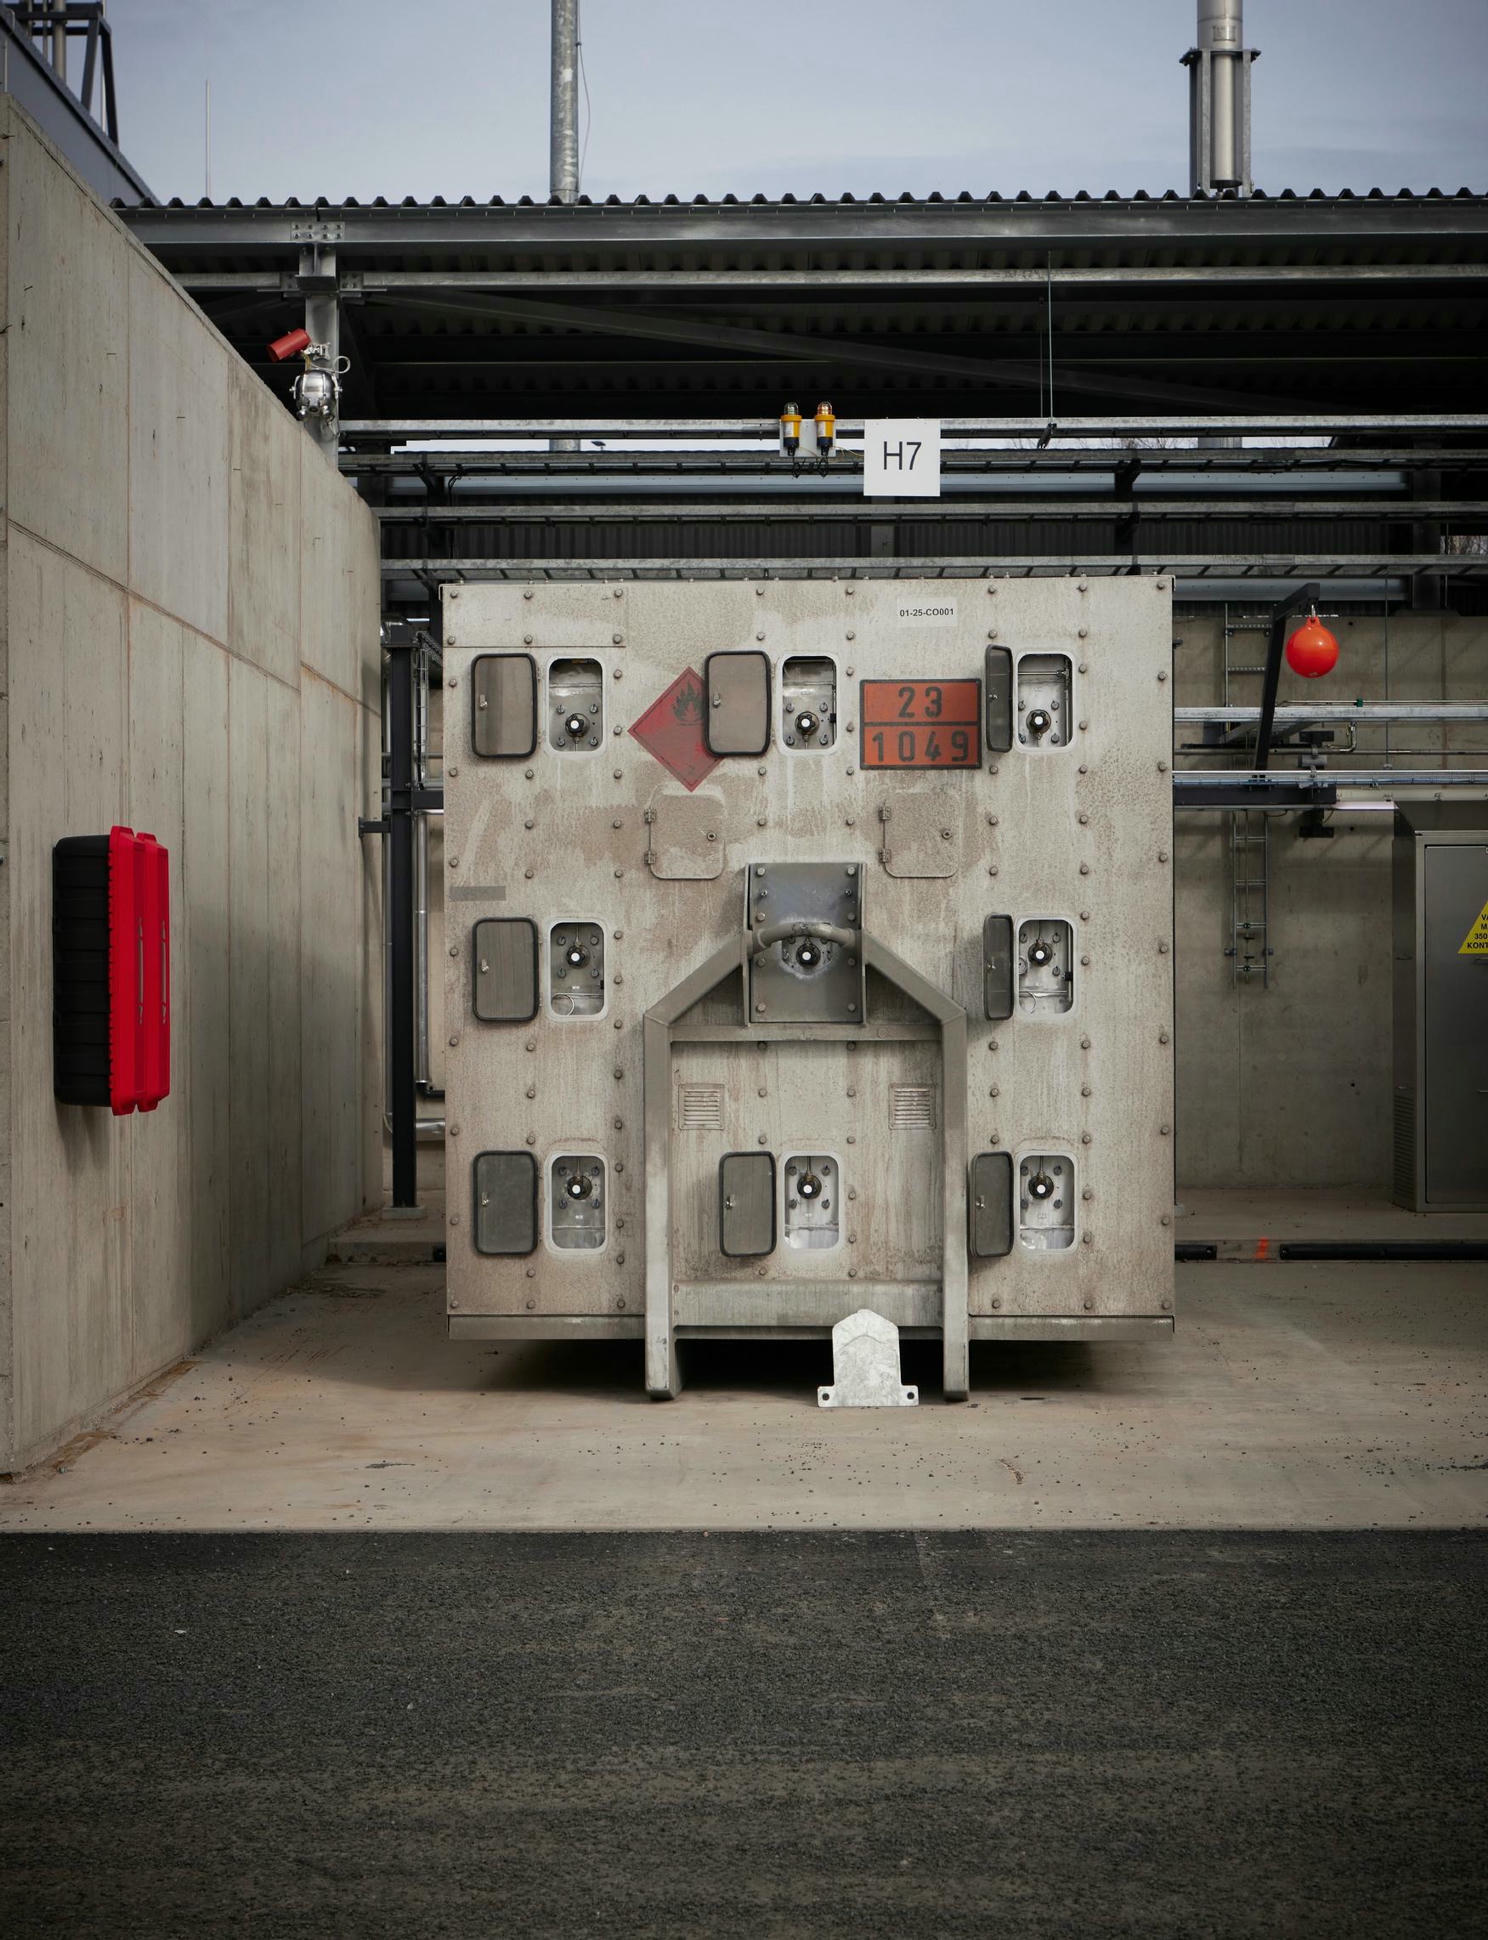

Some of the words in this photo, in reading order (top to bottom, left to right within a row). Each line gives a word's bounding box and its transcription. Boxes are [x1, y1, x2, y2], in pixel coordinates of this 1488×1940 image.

[883, 441, 922, 470] H7
[899, 608, 954, 617] 01-25-CO001
[897, 686, 943, 719] 23
[871, 730, 969, 762] 1049
